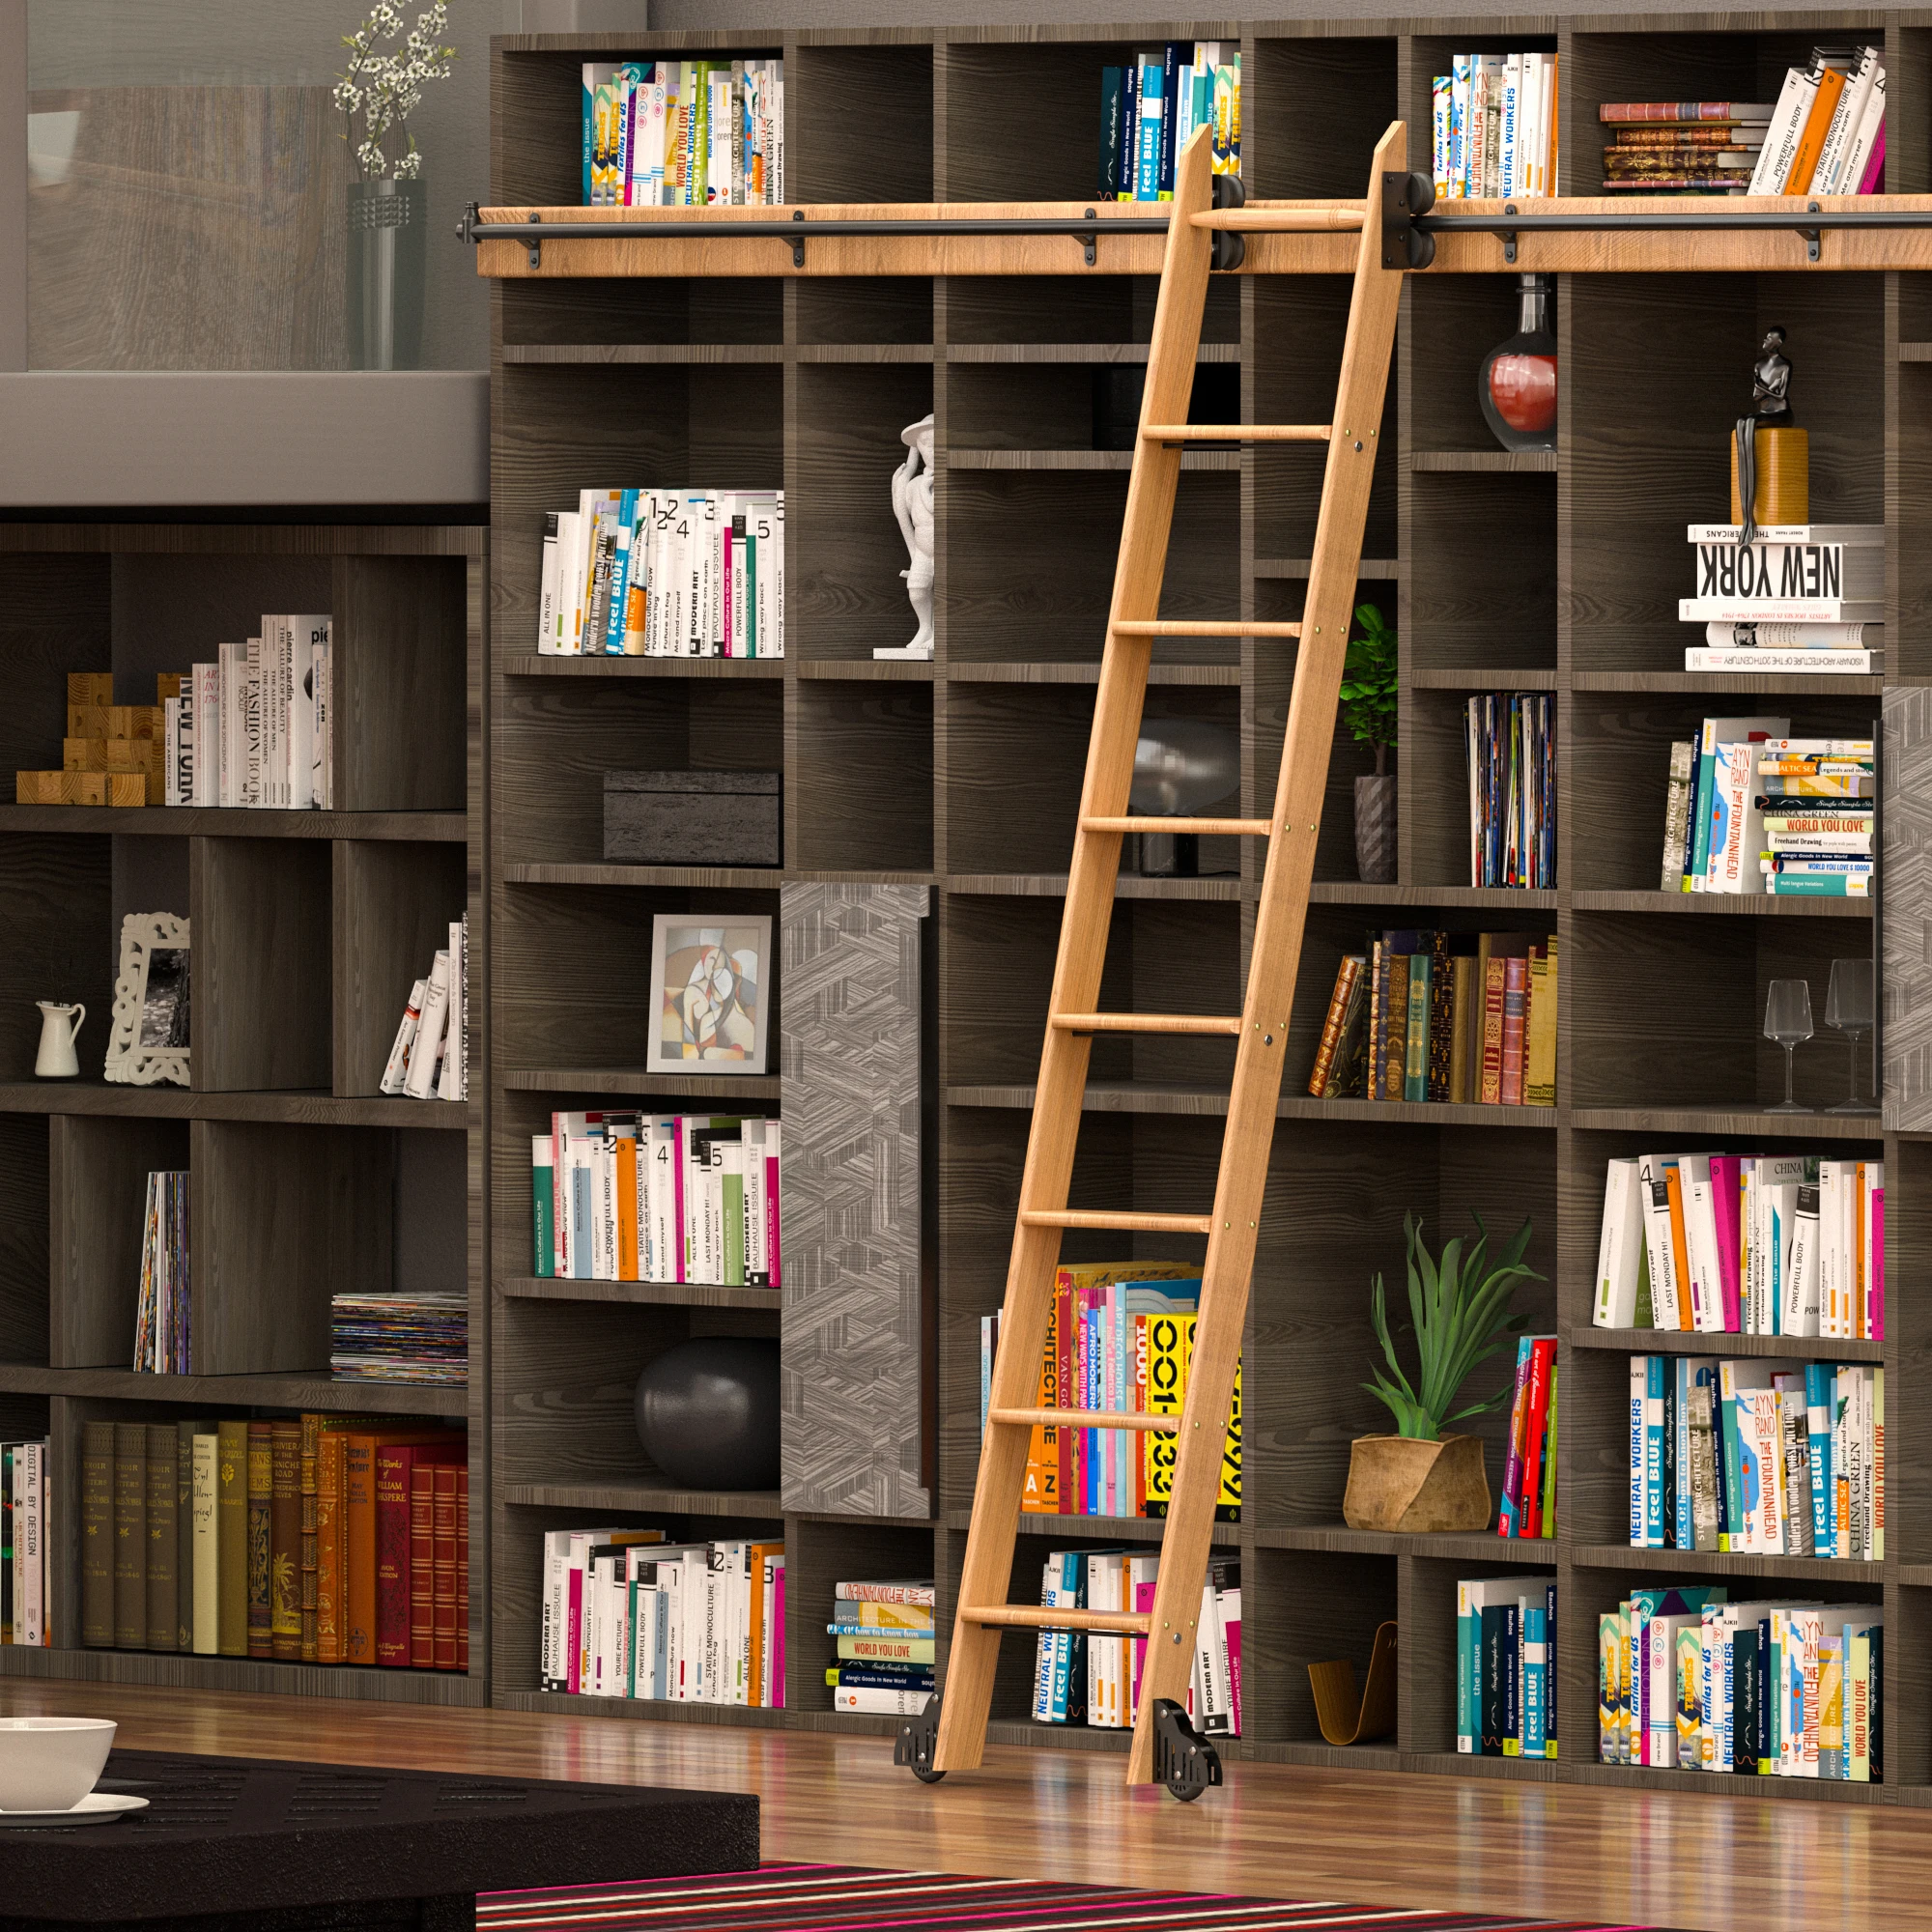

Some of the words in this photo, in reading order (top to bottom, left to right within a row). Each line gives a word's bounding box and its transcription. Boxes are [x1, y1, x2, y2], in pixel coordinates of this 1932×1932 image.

[679, 105, 688, 128] LOVE
[1506, 88, 1515, 143] WORKERS
[1816, 149, 1830, 177] STATIC
[1826, 86, 1851, 149] MONOCULTURE
[678, 131, 687, 151] YOU
[1144, 127, 1153, 159] BLUE
[1774, 129, 1795, 177] POWERFULL
[1790, 104, 1803, 128] BODY
[676, 155, 686, 187] WORLD
[1142, 165, 1151, 192] Feel
[651, 497, 656, 518] 1
[668, 499, 678, 520] 2
[705, 499, 715, 520] 3
[676, 520, 689, 538] 4
[758, 521, 770, 539] 5
[1700, 545, 1772, 597] YORK
[1780, 547, 1839, 597] NEW
[703, 586, 707, 598] on
[248, 640, 260, 675] THE
[674, 638, 679, 652] Me
[280, 684, 285, 696] OF
[248, 680, 260, 753] FASHION
[1666, 781, 1679, 850] ARCHITECTURE
[1787, 819, 1818, 831] WORLD
[1821, 820, 1839, 832] YOU
[1842, 821, 1864, 832] LOVE
[1726, 805, 1743, 879] FOUNTAINHEAD
[657, 1146, 668, 1164] 4
[713, 1148, 722, 1166] 5
[1775, 1163, 1803, 1175] CHINA
[1662, 1252, 1671, 1287] MONDAY
[1791, 1265, 1802, 1314] POWERFULL
[981, 1402, 990, 1427] living
[1632, 1399, 1640, 1468] WORKERS
[1649, 1437, 1660, 1481] BLUE
[1679, 1464, 1686, 1479] to
[1692, 1430, 1702, 1504] ARCHITECTURE
[1851, 1441, 1860, 1494] GREEN
[1026, 1474, 1037, 1492] A
[28, 1496, 36, 1508] BY
[1631, 1475, 1640, 1539] NEUTRAL
[1649, 1489, 1660, 1525] Feel
[1851, 1500, 1860, 1552] CHINA
[714, 1551, 724, 1572] 2
[854, 1642, 877, 1655] WORLD
[879, 1644, 893, 1656] YOU
[895, 1645, 910, 1658] LOVE
[1038, 1658, 1051, 1714] NEUTRAL
[1054, 1668, 1065, 1702] Feel
[1205, 1672, 1213, 1712] MODERN
[1528, 1672, 1537, 1706] BLUE
[1855, 1680, 1865, 1701] LOVE
[1528, 1712, 1537, 1741] Feel
[1855, 1704, 1865, 1722] YOU
[1855, 1725, 1866, 1757] WORLD
